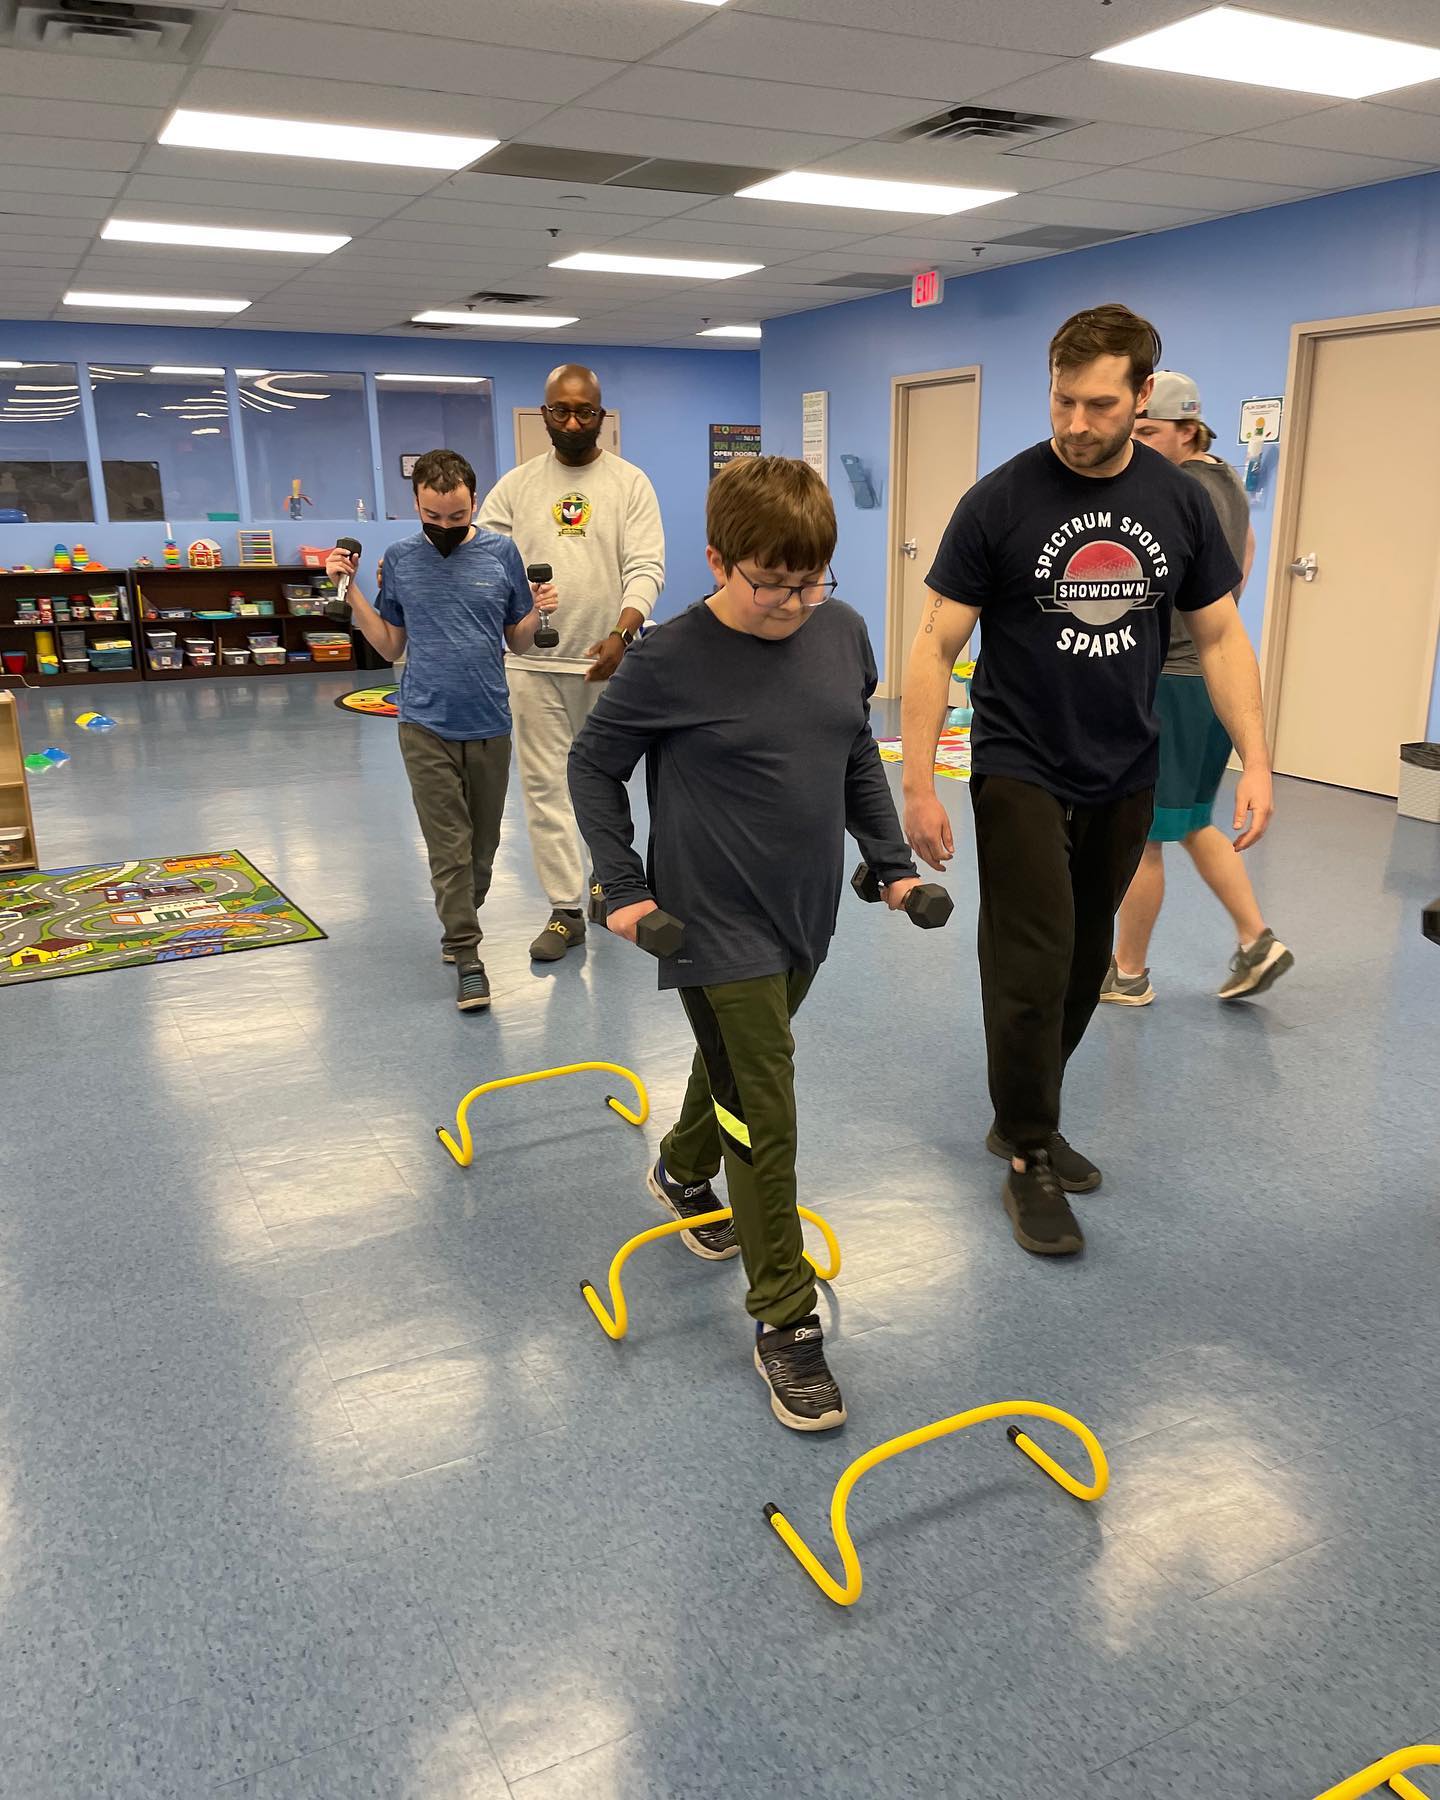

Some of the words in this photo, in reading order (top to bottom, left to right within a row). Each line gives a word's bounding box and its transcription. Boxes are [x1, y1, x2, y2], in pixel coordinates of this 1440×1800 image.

[1035, 511, 1112, 580] SPECTRUM
[1119, 516, 1169, 578] SPORTS
[1059, 582, 1145, 598] SHOWDOWN
[1056, 625, 1137, 658] SPARK
